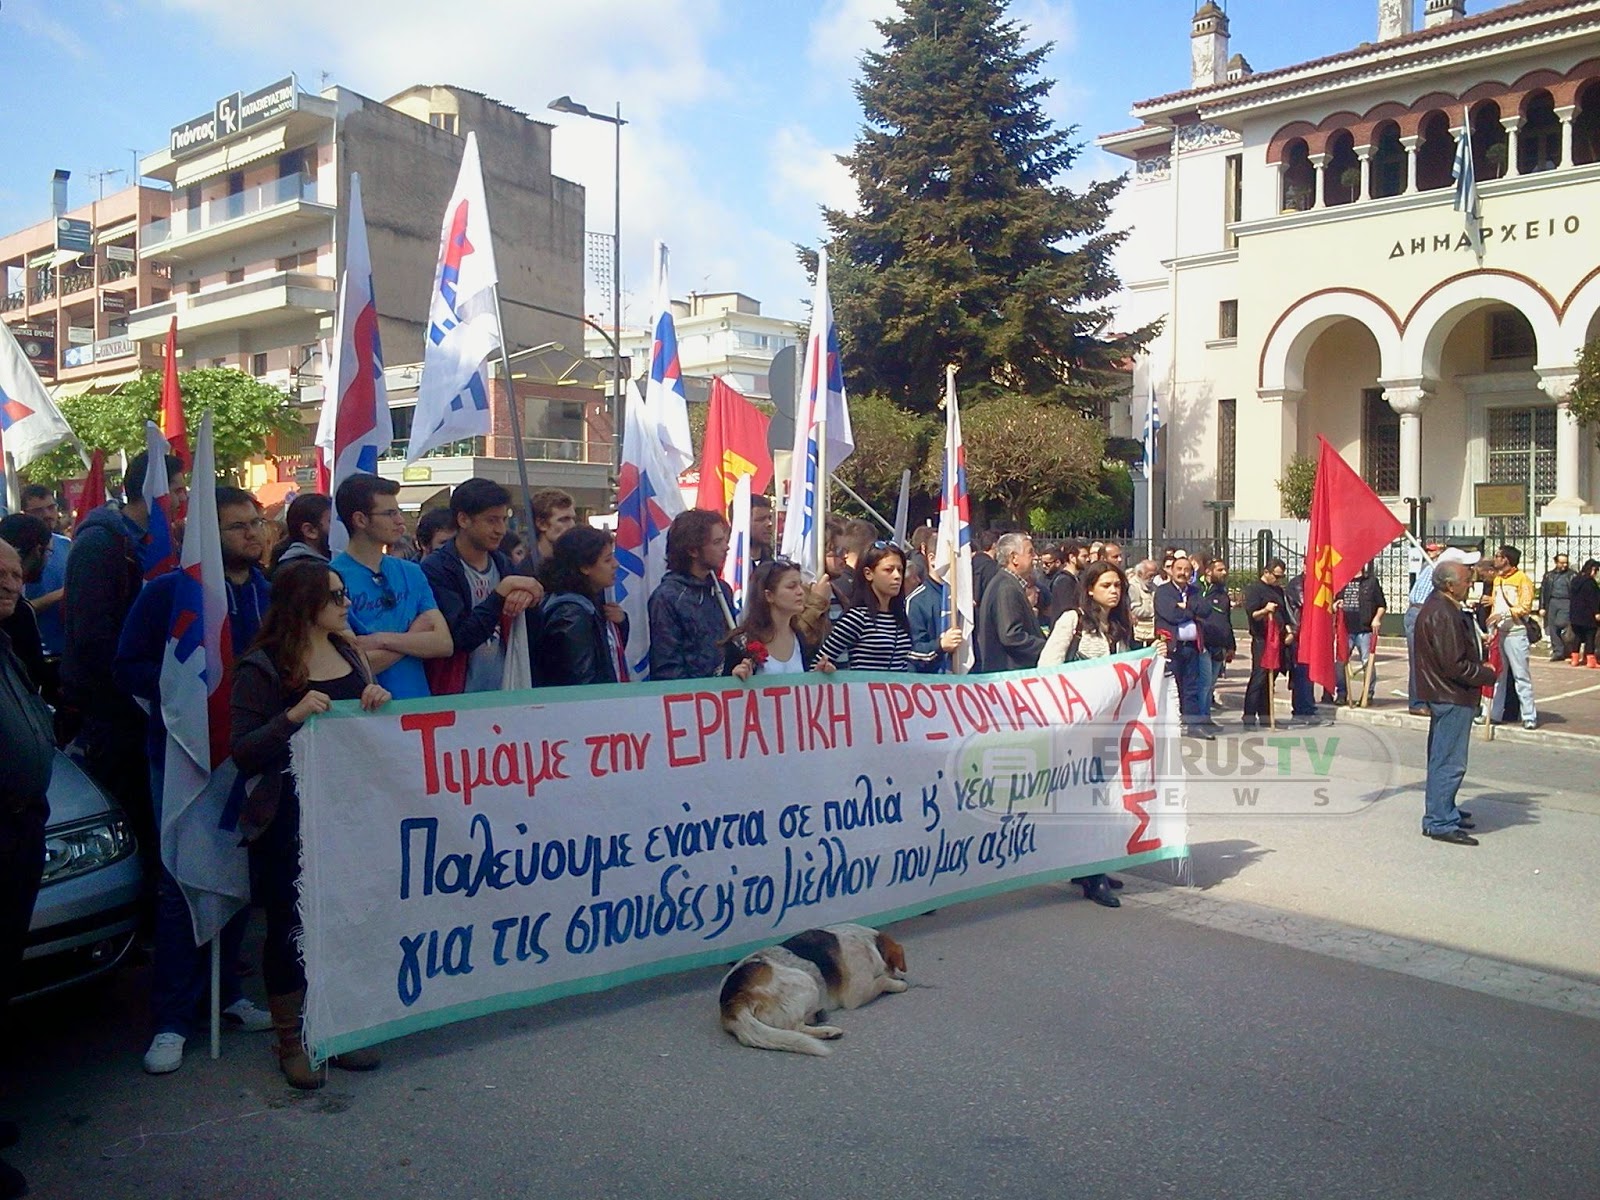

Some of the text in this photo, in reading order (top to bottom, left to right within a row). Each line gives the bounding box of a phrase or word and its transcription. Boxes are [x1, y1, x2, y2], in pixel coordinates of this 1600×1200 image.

[171, 120, 215, 151] Γκόντος
[1388, 215, 1580, 259] ΔΗΜΑΡΧΕΙΟ
[400, 673, 1093, 806] Τιμάμε την ΕΡΓΑΤΙΚΗ ΠΡΩΤΟΜΑΓΙΑ
[400, 813, 635, 900] Παλεύουμε
[644, 801, 769, 859] ενάντια
[778, 803, 814, 839] σε
[823, 774, 903, 832] παλιά
[953, 762, 996, 812] νέα
[1007, 749, 1107, 815] μνημόνια
[397, 923, 476, 1007] για
[491, 911, 552, 966] τις
[564, 863, 709, 955] σπουδές
[742, 875, 775, 917] το
[770, 836, 881, 929] μέλλον
[886, 845, 932, 888] που
[929, 827, 975, 887] μας
[977, 811, 1038, 870] αξίζει
